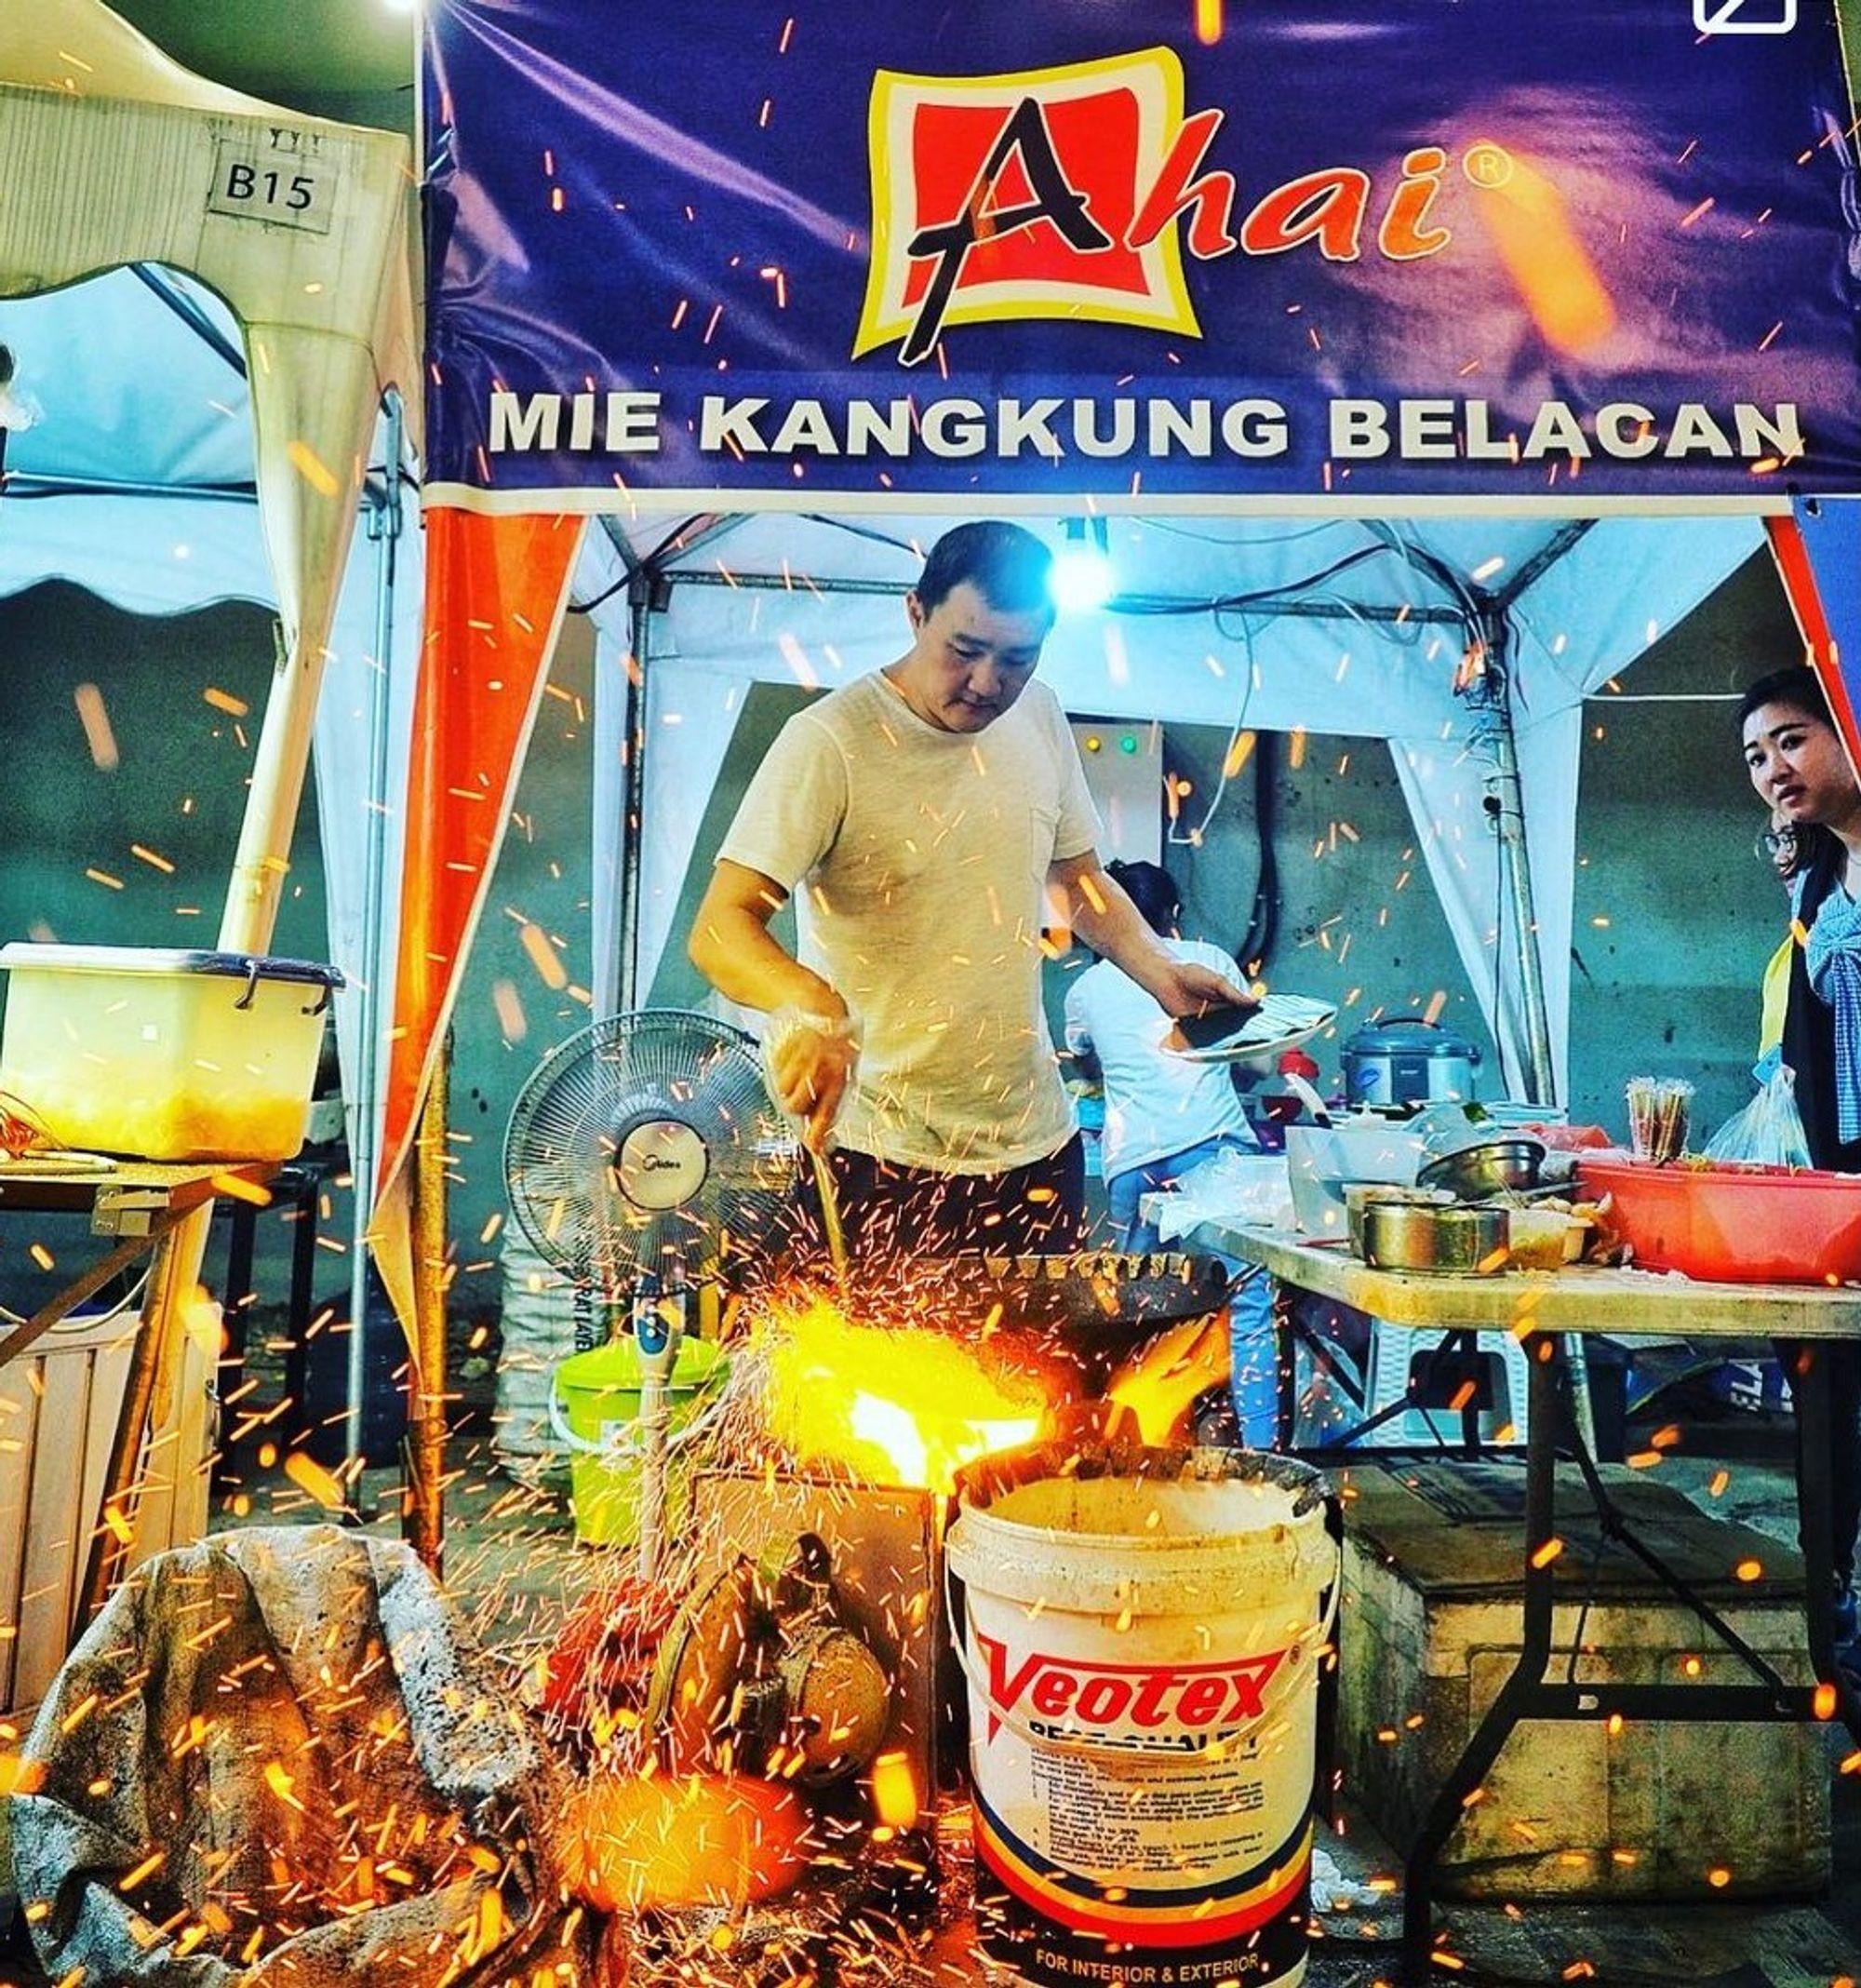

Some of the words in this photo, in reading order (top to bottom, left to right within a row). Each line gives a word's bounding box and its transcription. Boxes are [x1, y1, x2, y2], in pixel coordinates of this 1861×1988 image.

[226, 164, 315, 210] B15
[897, 96, 1453, 367] Ahai
[489, 391, 661, 452] MIE
[699, 395, 1290, 458] KANGKUNG
[1328, 398, 1805, 459] BELACAN
[977, 1631, 1288, 1746] Veotex
[1036, 1948, 1068, 1971] FOR
[1072, 1959, 1156, 1983] INTERIOR
[1161, 1966, 1173, 1983] &
[1179, 1953, 1260, 1981] EXTERIOR
